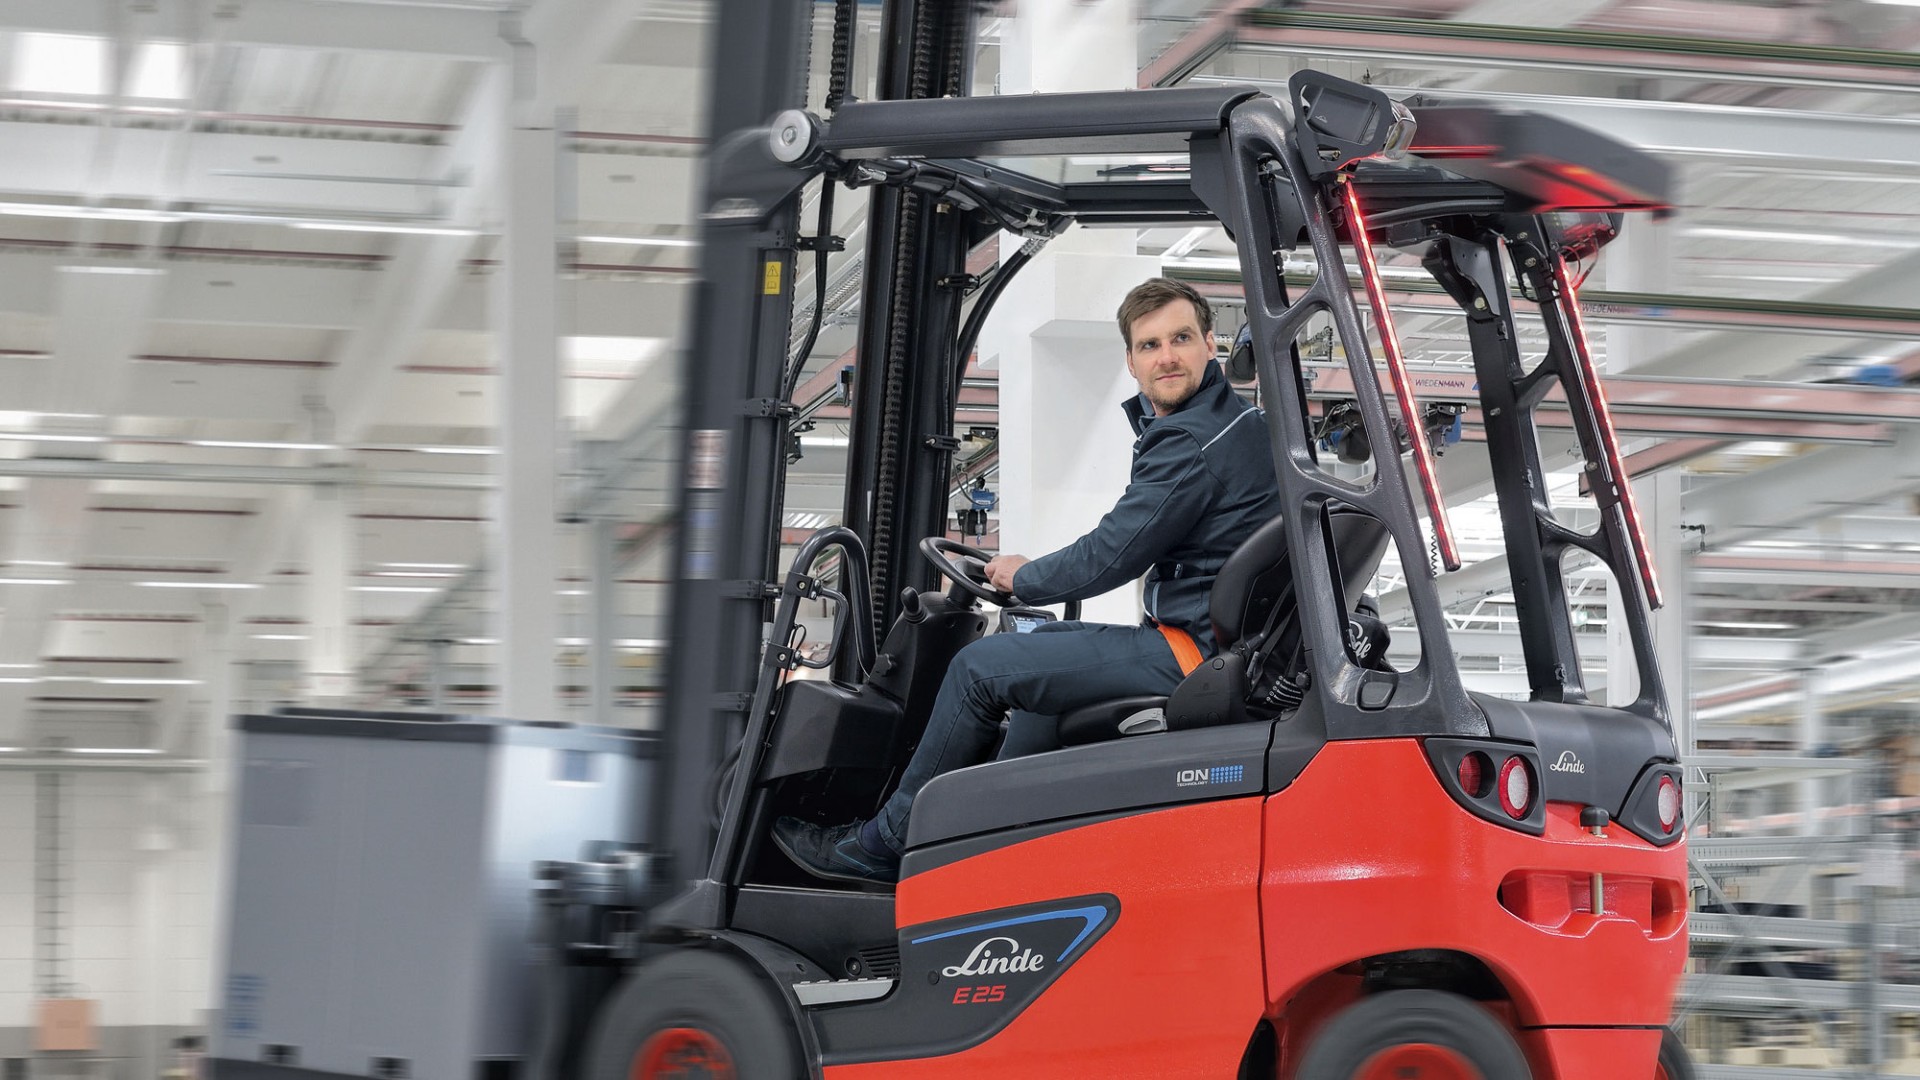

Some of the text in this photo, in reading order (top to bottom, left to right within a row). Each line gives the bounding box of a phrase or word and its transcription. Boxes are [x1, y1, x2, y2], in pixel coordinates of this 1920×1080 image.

[1582, 303, 1632, 314] WIEDENM
[1415, 379, 1466, 389] WIEDENMANN
[1549, 750, 1586, 774] Linde
[1176, 768, 1209, 783] ION
[942, 936, 1044, 977] Linde
[952, 985, 1007, 1004] E 25
